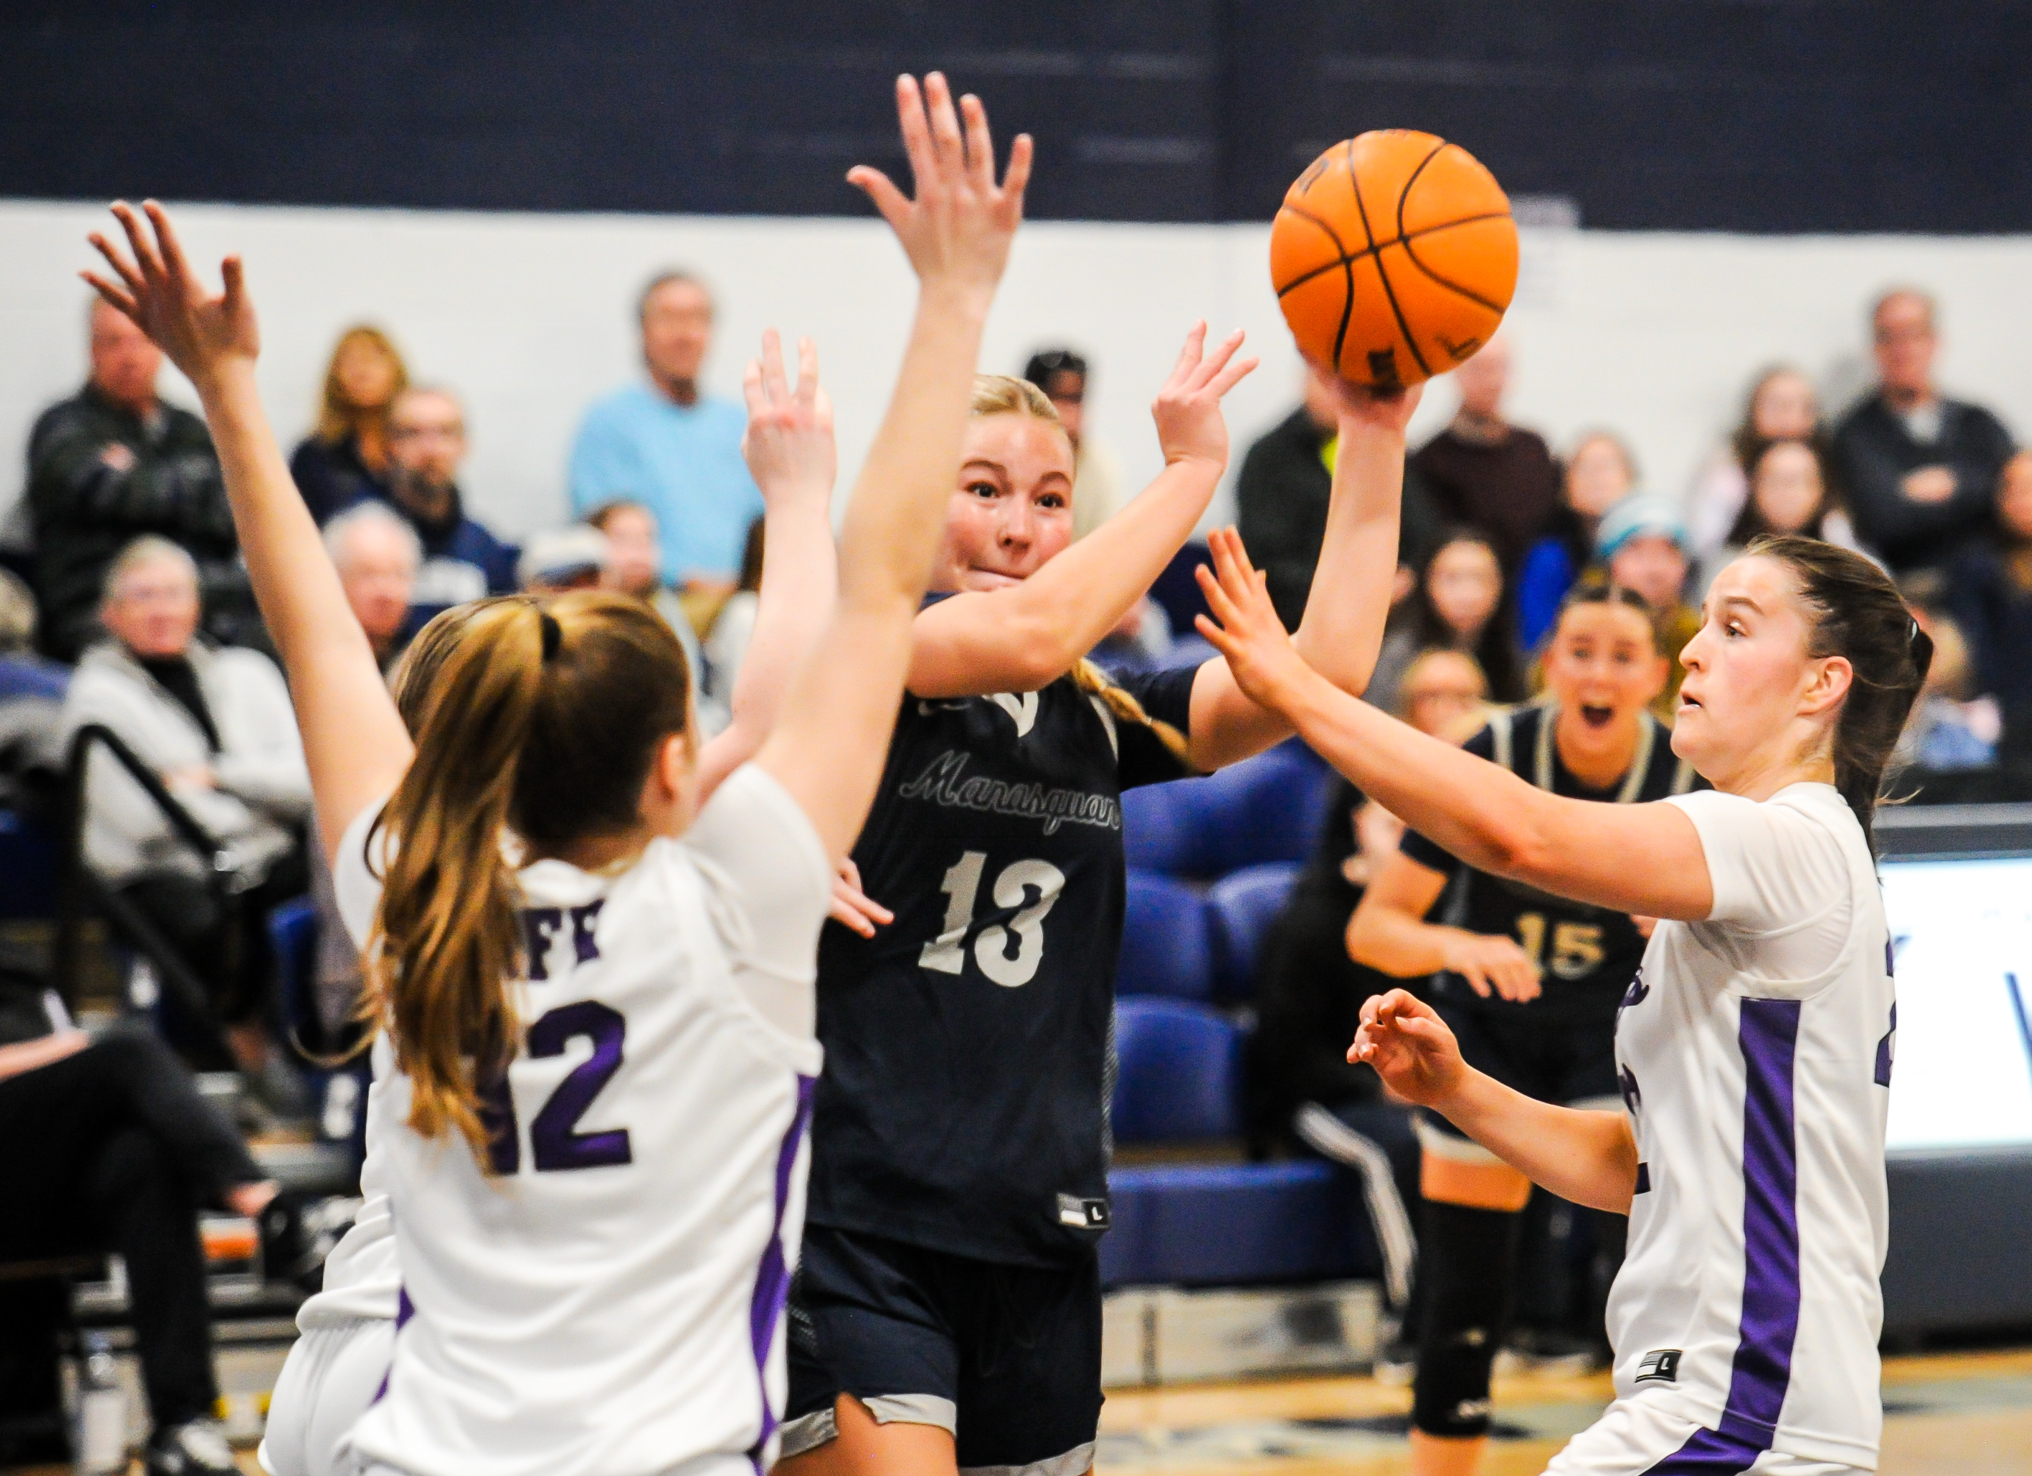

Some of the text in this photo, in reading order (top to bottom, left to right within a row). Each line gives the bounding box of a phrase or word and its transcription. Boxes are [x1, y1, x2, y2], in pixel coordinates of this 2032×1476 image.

[900, 749, 1121, 836] Manasquan
[918, 851, 1066, 987] 13
[1516, 911, 1605, 980] 15
